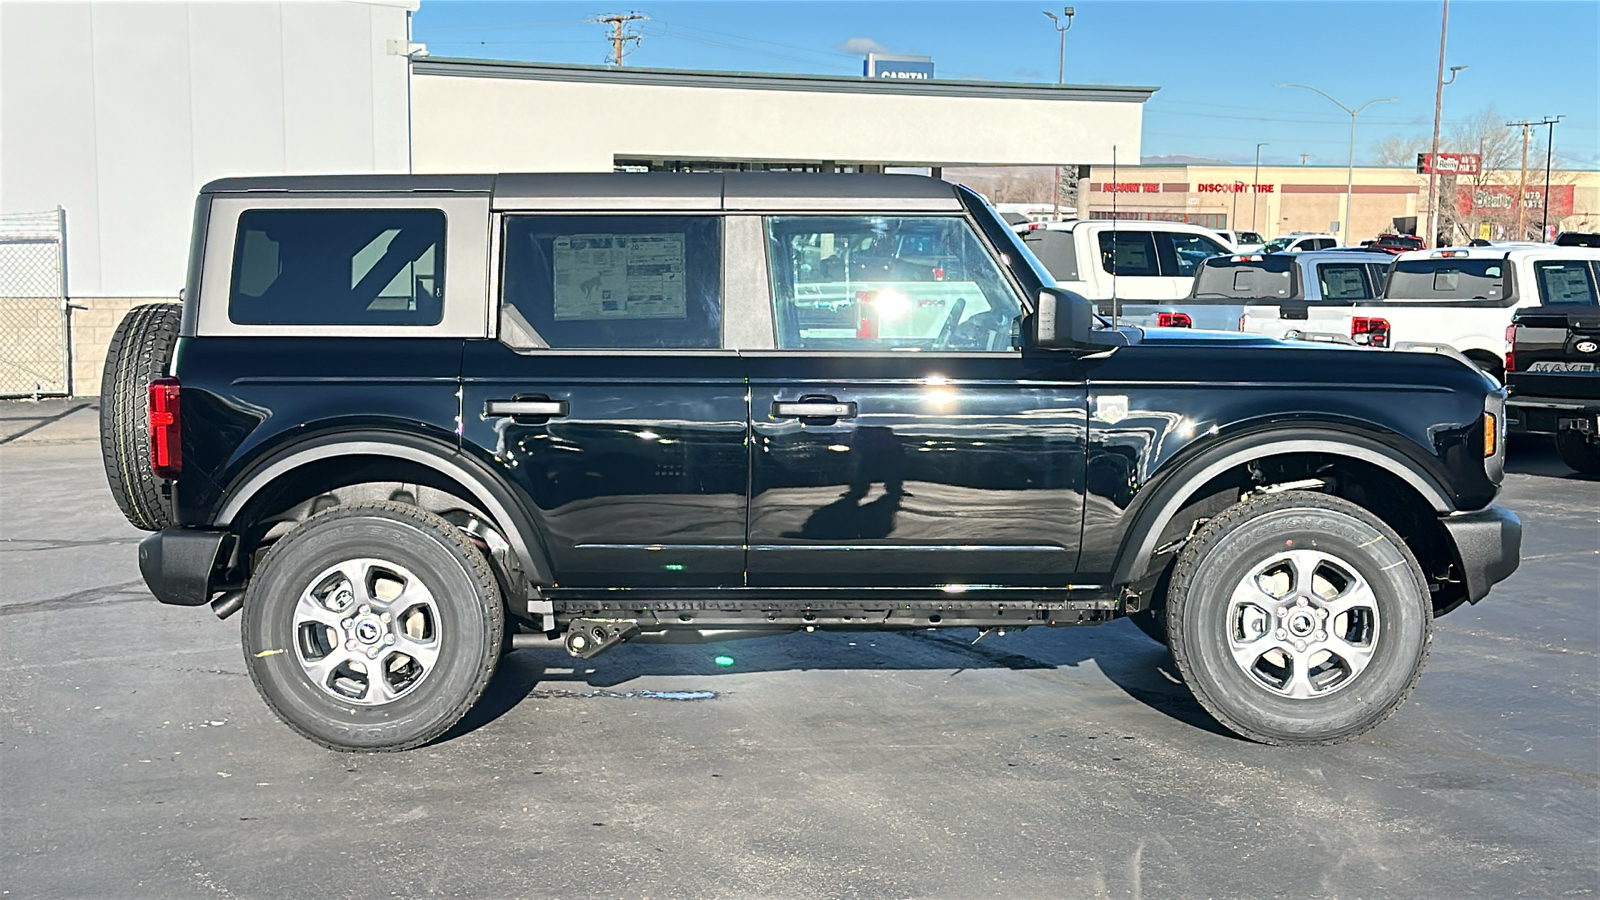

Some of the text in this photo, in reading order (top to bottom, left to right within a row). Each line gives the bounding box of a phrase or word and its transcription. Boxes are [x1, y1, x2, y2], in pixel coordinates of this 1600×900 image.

[1142, 183, 1161, 193] TIRE
[1197, 183, 1274, 194] DISCOUNT TIRE
